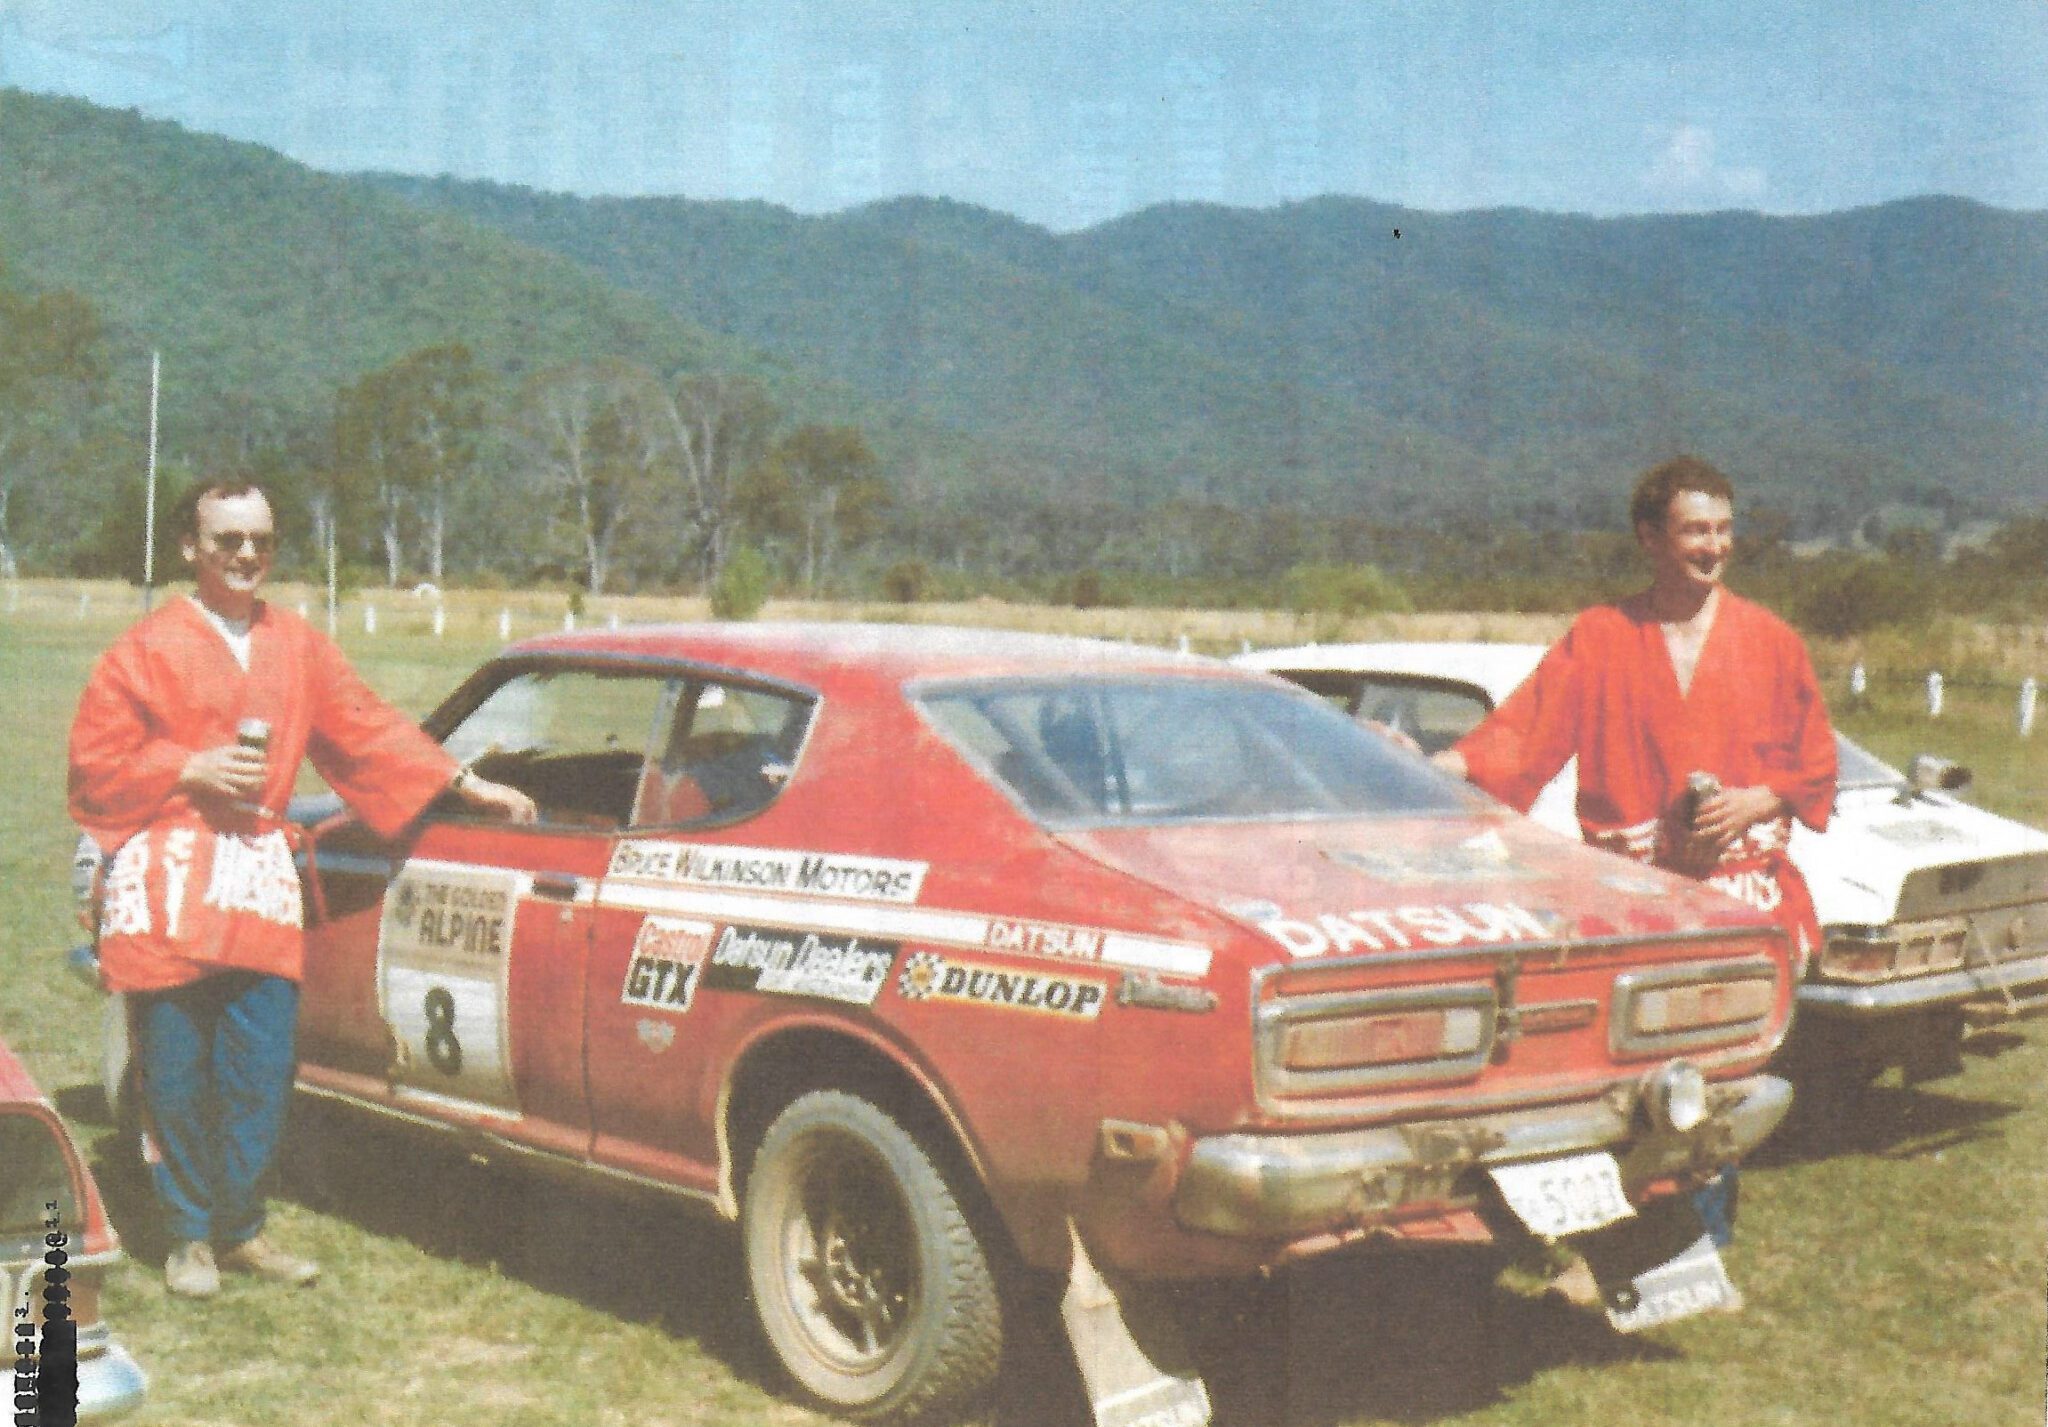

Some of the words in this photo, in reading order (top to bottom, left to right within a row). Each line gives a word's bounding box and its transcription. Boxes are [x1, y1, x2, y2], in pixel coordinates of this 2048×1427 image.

[613, 843, 672, 877] BRUCE
[675, 847, 790, 886] WILKINSON
[796, 855, 913, 898] MOTORS
[419, 907, 503, 953] ALPINE
[712, 926, 798, 971] Datsun
[991, 919, 1099, 960] DATSUN
[1259, 902, 1550, 958] DATSUN
[626, 956, 697, 1006] GTX
[941, 965, 1101, 1014] DUNLOP
[424, 987, 463, 1077] 8
